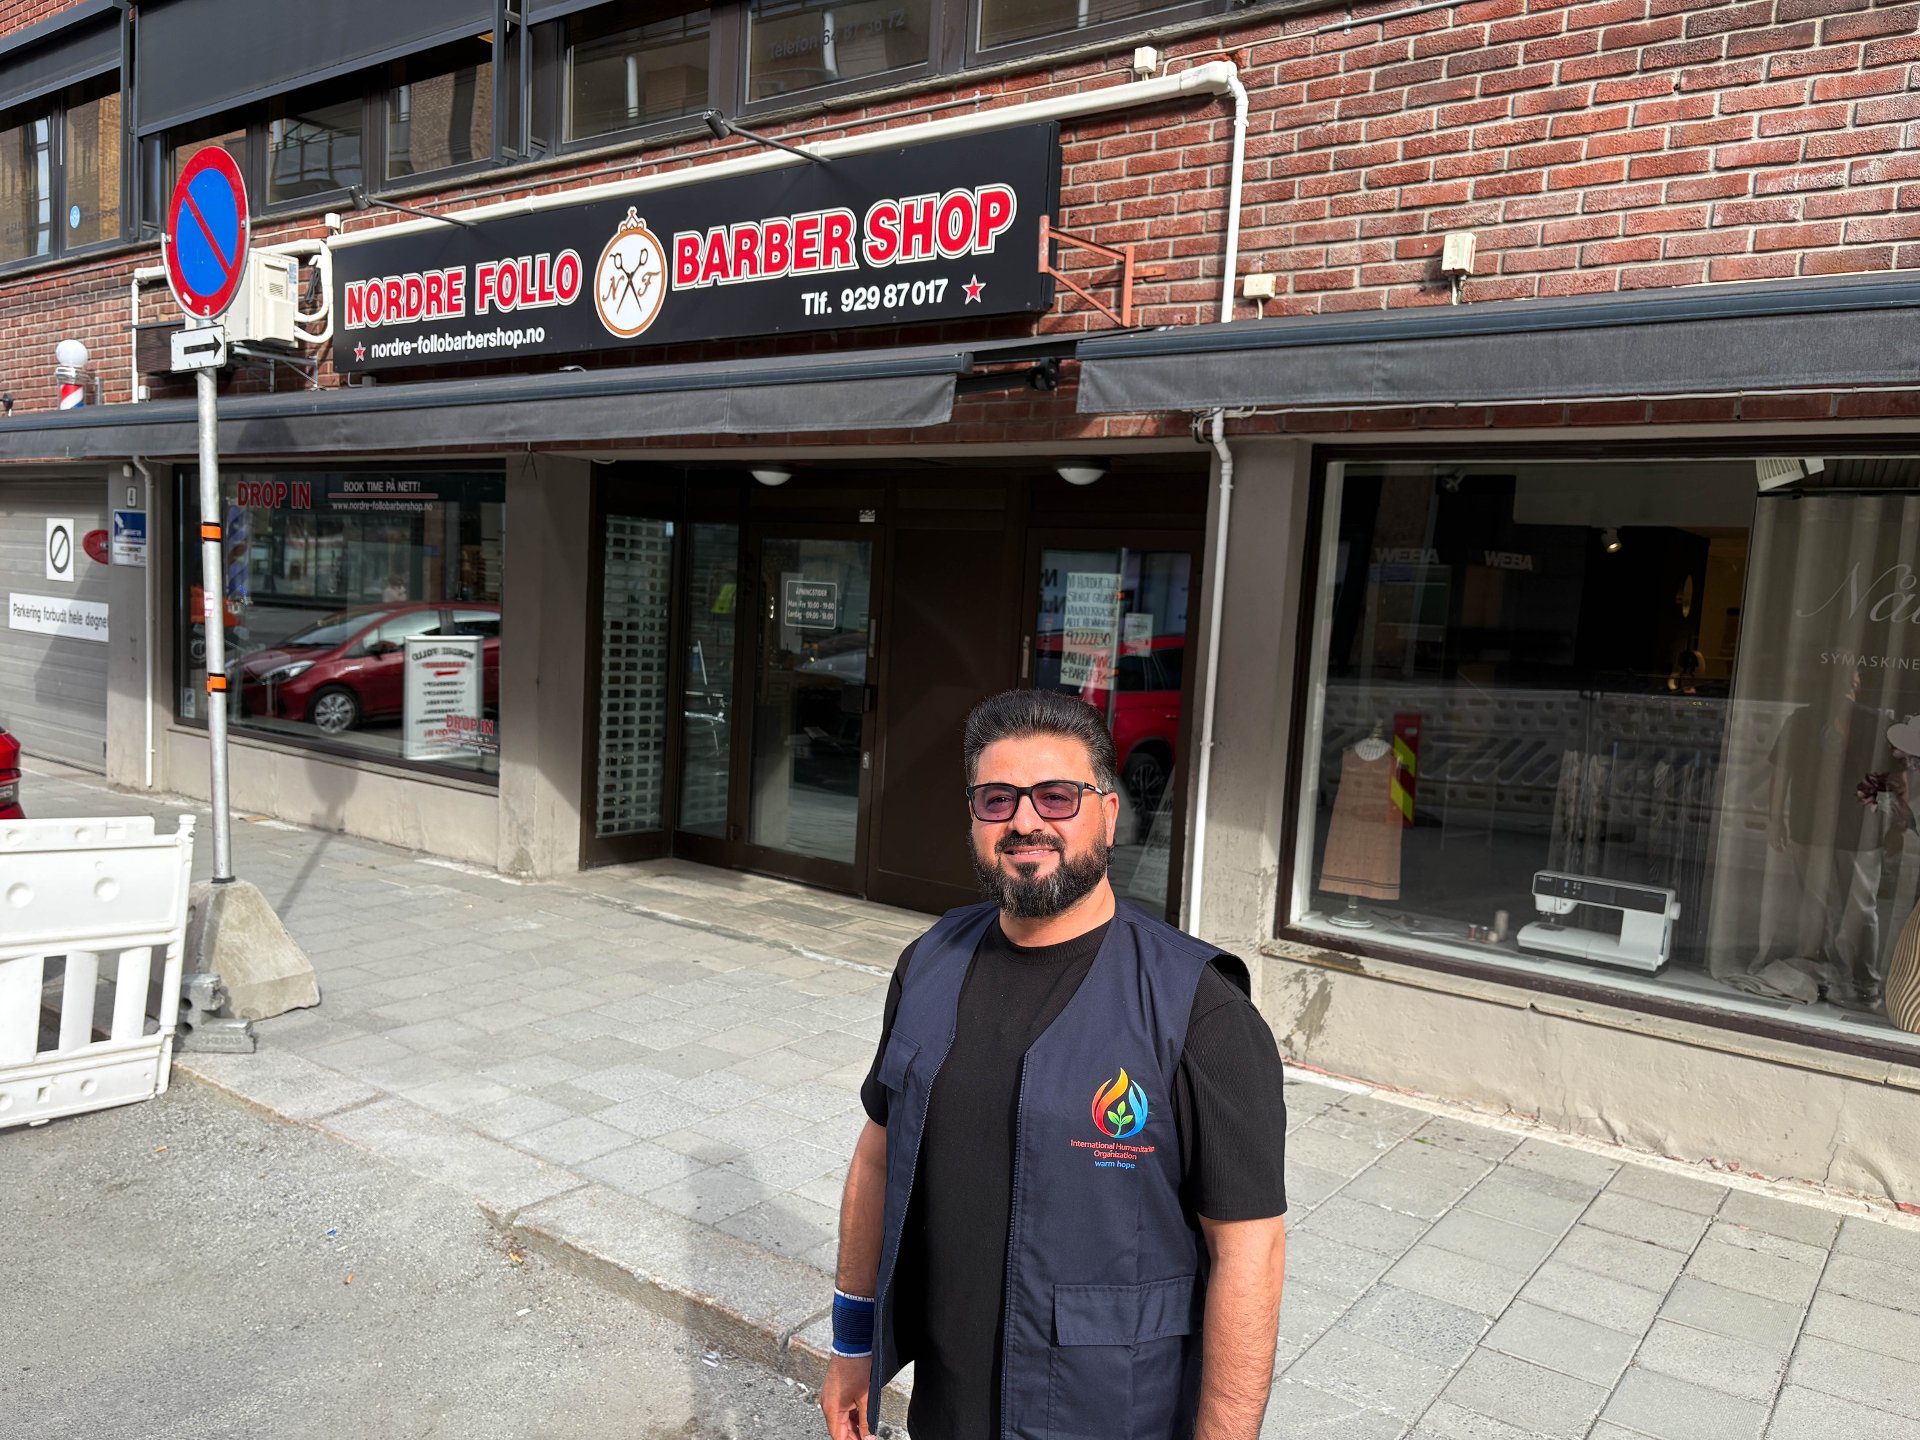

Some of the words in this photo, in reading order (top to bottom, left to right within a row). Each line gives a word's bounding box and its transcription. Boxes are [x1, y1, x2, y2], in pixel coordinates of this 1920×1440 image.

[767, 34, 818, 58] Telefon
[888, 9, 905, 29] 72
[672, 206, 859, 291] BARBER
[863, 182, 1017, 268] SHOP
[345, 265, 466, 330] NORDRE
[475, 248, 582, 316] FOLLO
[602, 275, 624, 302] N
[801, 291, 833, 316] Tlf.
[371, 326, 545, 359] nordre-follobarbershop.no
[237, 481, 287, 509] DROP
[291, 481, 311, 509] IN
[344, 481, 364, 493] BOOK
[367, 481, 383, 493] TIME
[385, 478, 396, 493] PÅ
[398, 481, 421, 493] NETT!
[331, 501, 433, 513] www.nordre-follobarbershop.no
[13, 603, 41, 622] Parkering
[43, 607, 67, 622] forbudt
[68, 609, 83, 625] hele
[446, 714, 478, 731] DROP
[480, 719, 494, 736] IN
[1070, 1139, 1115, 1150] International
[1094, 1150, 1137, 1160] Organization
[1095, 1160, 1115, 1168] warm
[1117, 1160, 1136, 1170] hope
